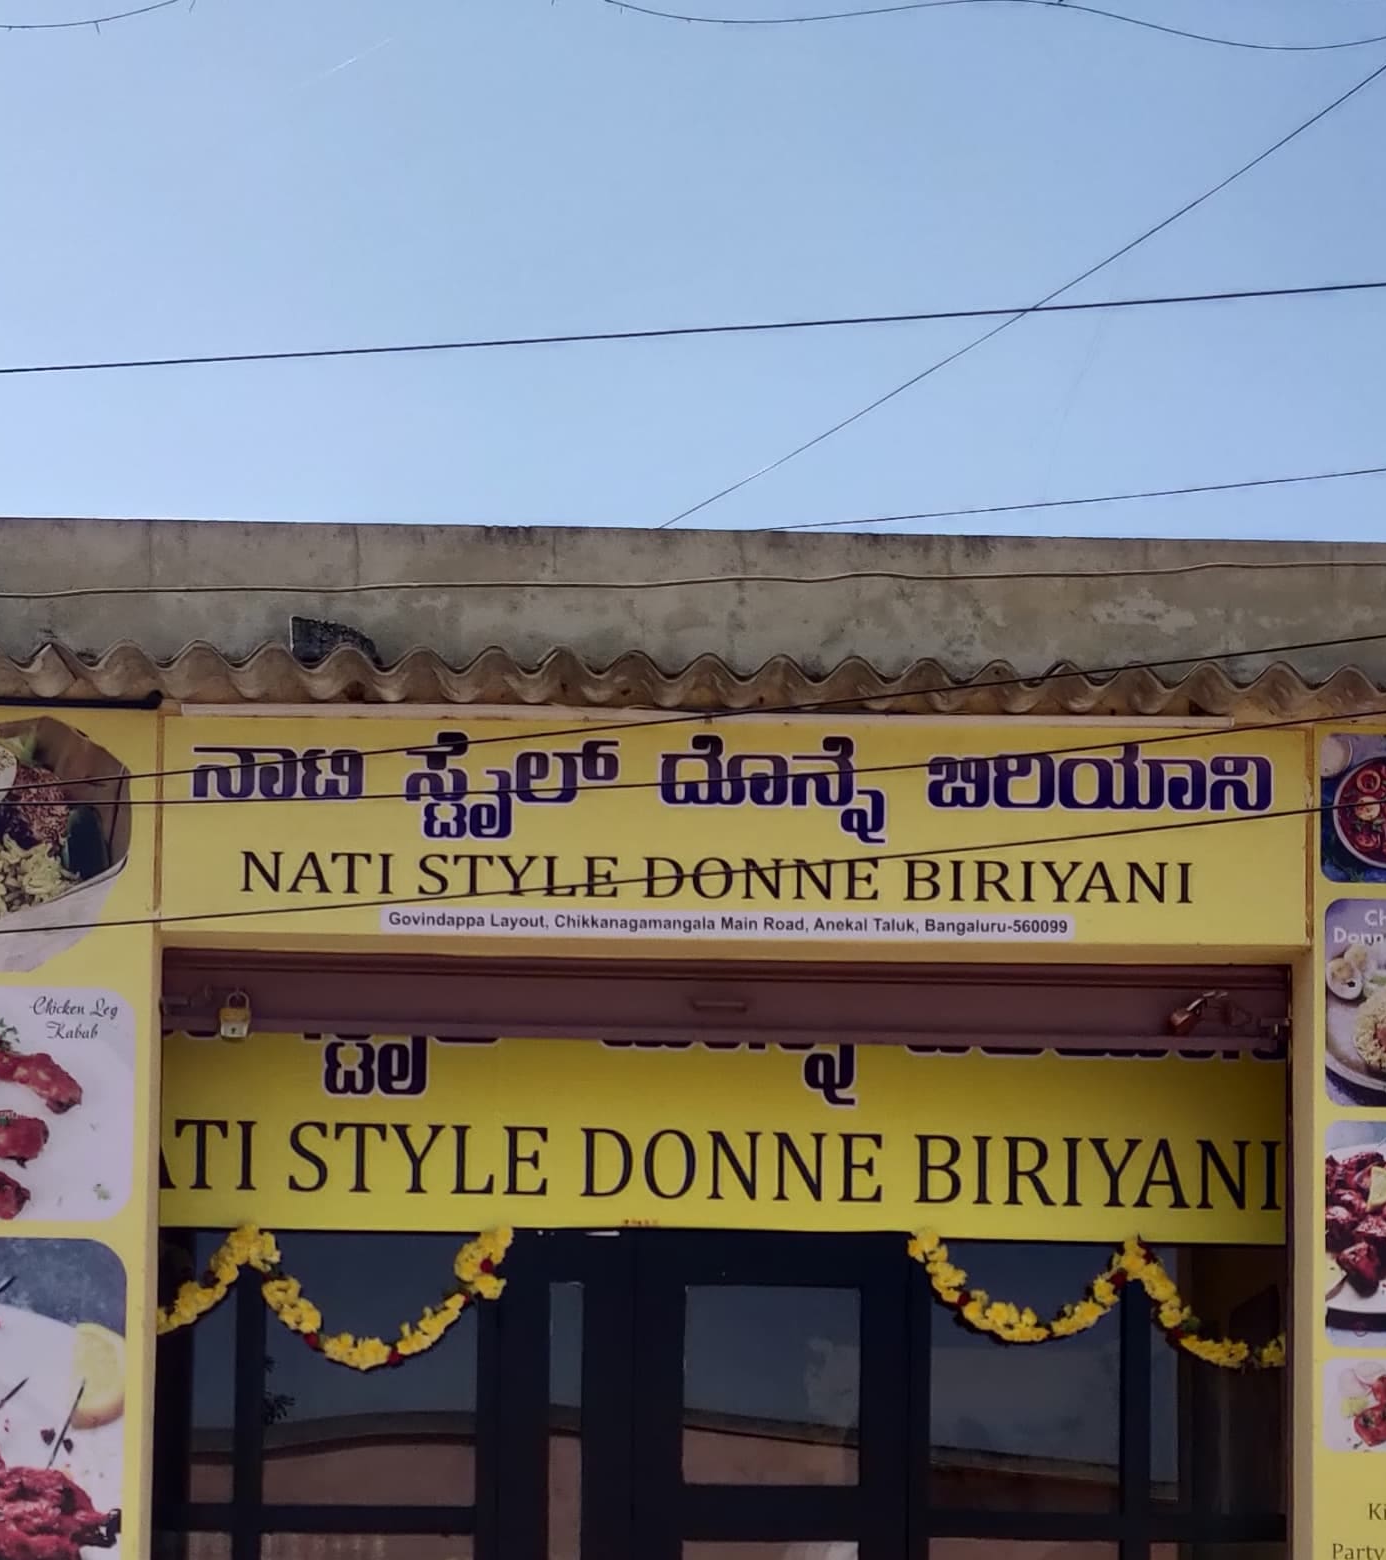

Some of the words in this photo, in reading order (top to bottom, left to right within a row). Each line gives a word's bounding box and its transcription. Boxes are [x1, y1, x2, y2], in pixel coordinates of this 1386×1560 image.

[192, 746, 364, 800] ನಾಟಿ
[404, 731, 619, 839] ಸ್ಟೈಲ್
[660, 734, 886, 844] ದೊನ್ನೆ
[927, 742, 1271, 811] ಬಿರಿಯಾನಿ
[240, 851, 394, 895] NATI
[417, 854, 619, 898] STYLE
[642, 856, 880, 902] DONNE
[903, 860, 1195, 904] BIRIYANI
[388, 911, 485, 930] Govindappa
[490, 913, 549, 931] Layout,
[554, 914, 715, 933] Chikkanagamangala
[721, 916, 758, 931] Main
[764, 916, 809, 933] Road,
[814, 917, 868, 933] Anekal
[874, 918, 920, 935] Taluk,
[925, 919, 1068, 936] Bangaluru-560099
[30, 996, 85, 1016] Chicken
[89, 998, 118, 1020] Leg
[46, 1021, 99, 1040] Kabab
[287, 1120, 548, 1195] STYLE
[580, 1127, 884, 1203] DONNE
[913, 1133, 1282, 1212] BIRIYANI
